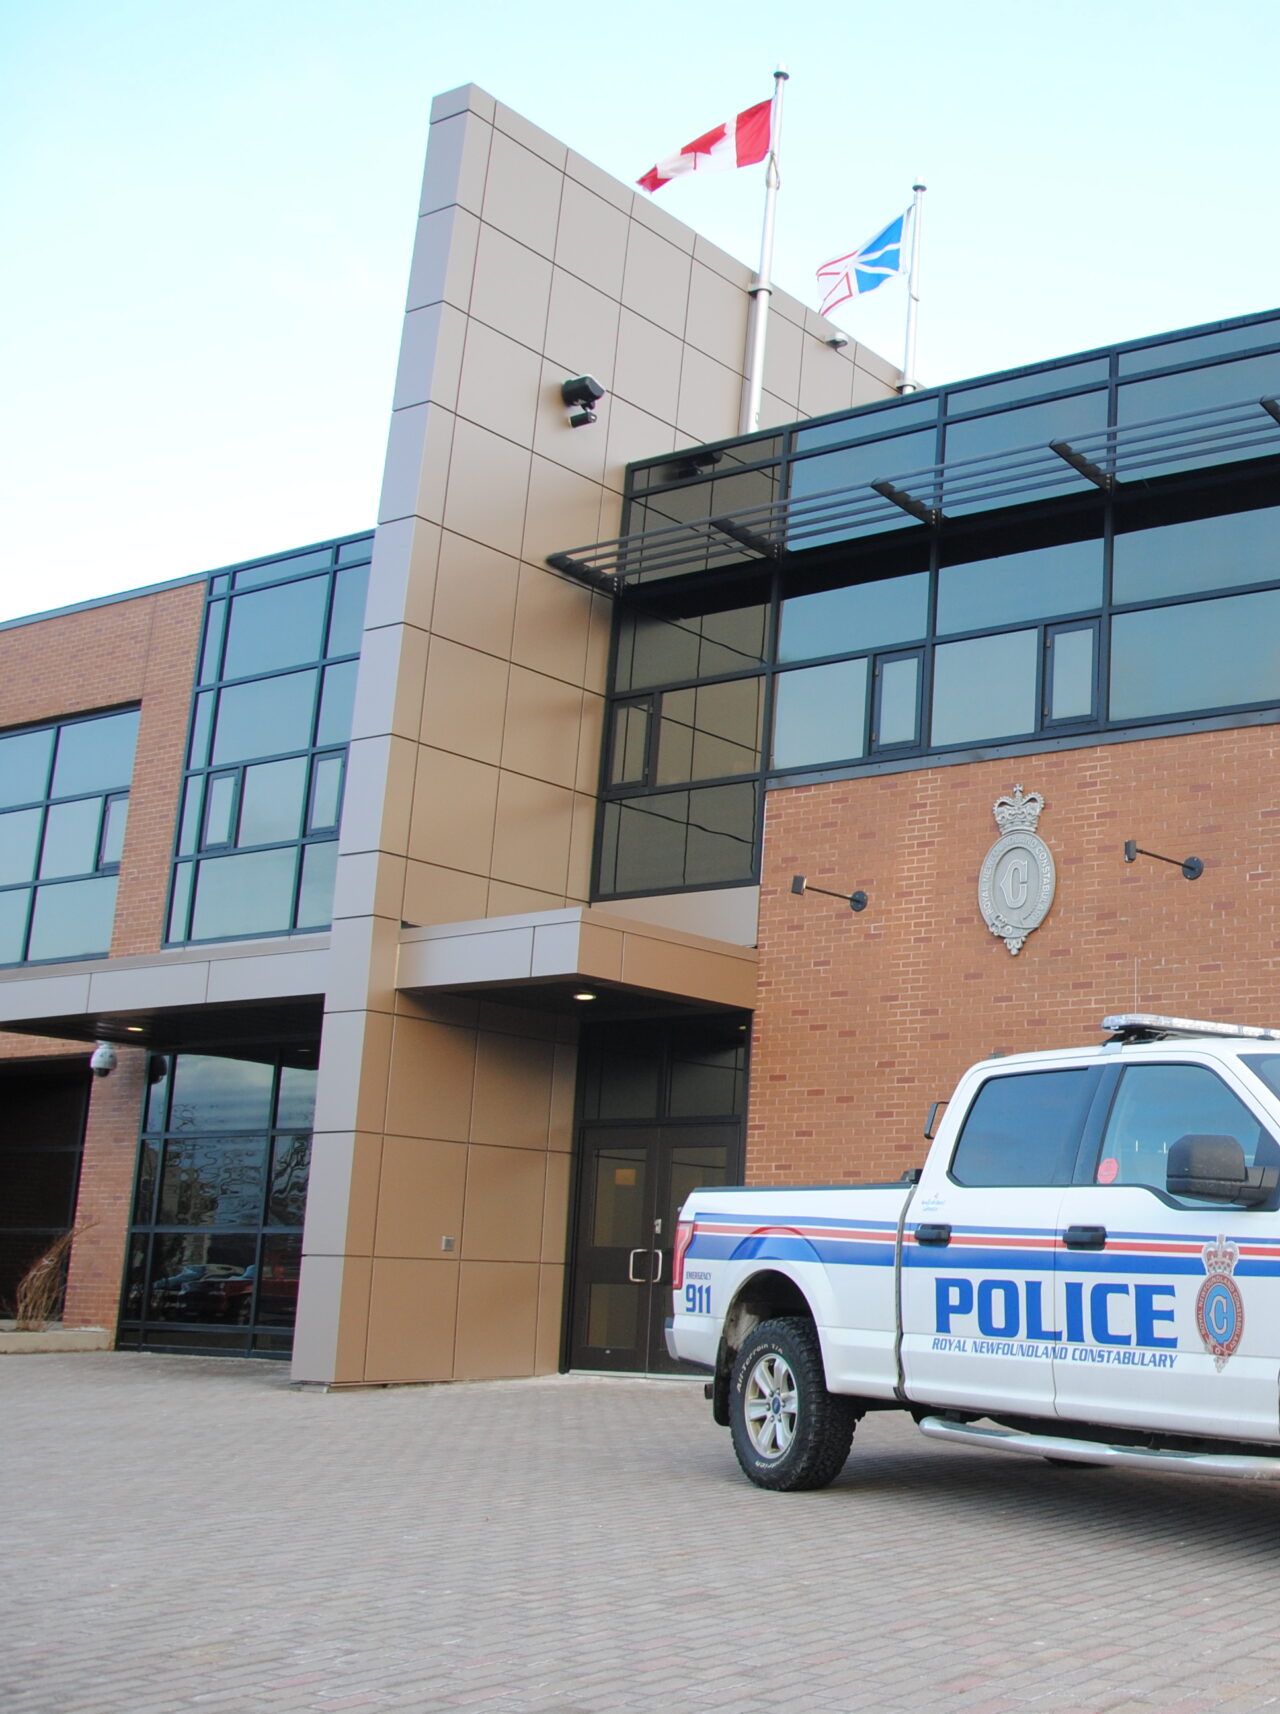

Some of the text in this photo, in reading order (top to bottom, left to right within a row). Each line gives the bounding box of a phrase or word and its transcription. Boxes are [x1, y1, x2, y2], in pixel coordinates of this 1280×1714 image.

[1000, 859, 1028, 909] C
[685, 1284, 711, 1314] 911
[935, 1277, 1178, 1349] POLICE
[1209, 1295, 1228, 1334] C
[932, 1337, 1178, 1368] ROYAL NEWFOUNDLAND CONSTABULARY
